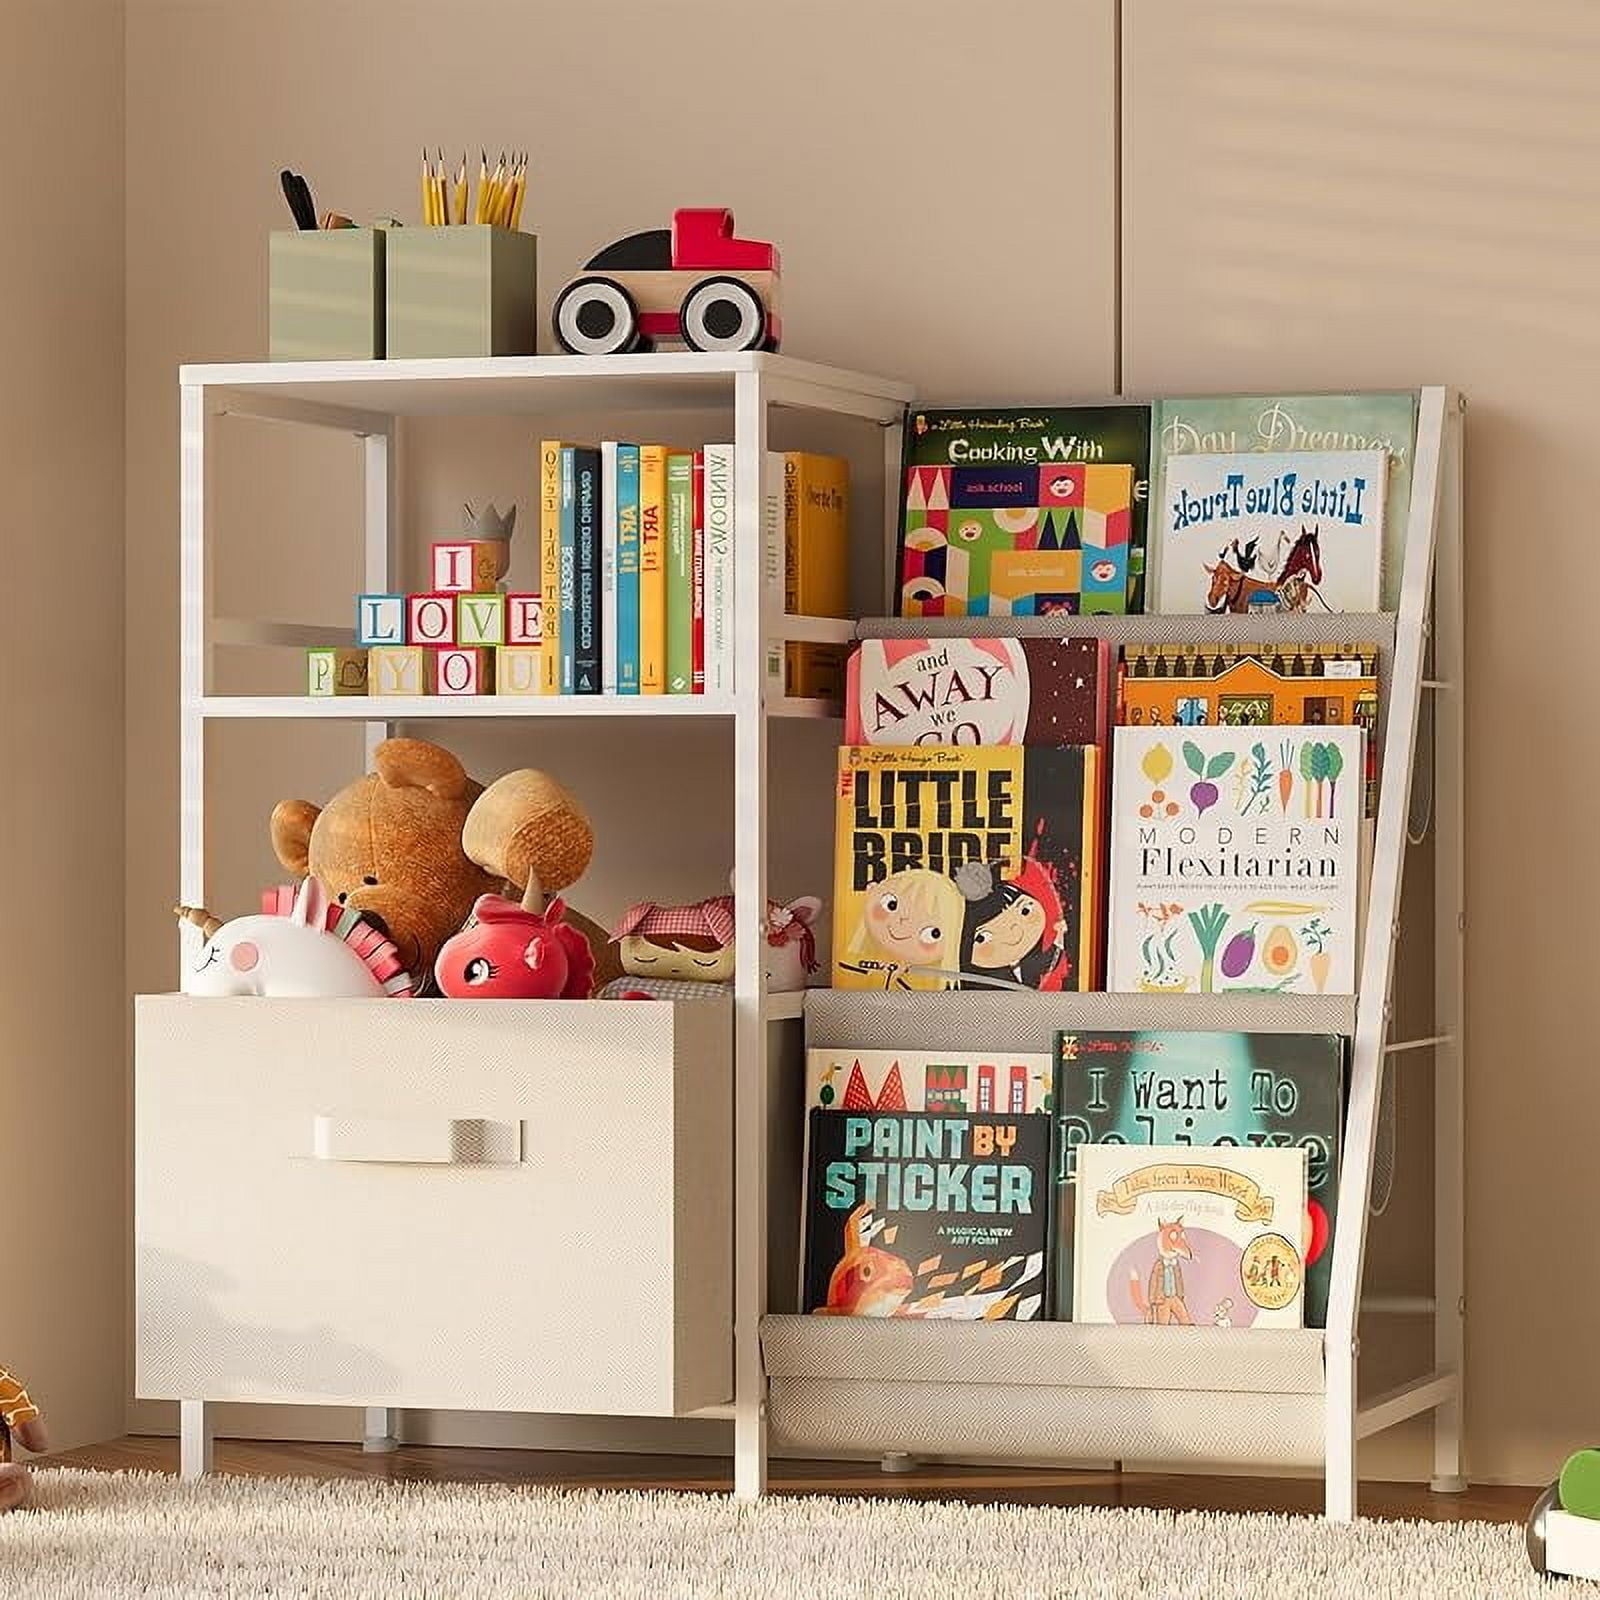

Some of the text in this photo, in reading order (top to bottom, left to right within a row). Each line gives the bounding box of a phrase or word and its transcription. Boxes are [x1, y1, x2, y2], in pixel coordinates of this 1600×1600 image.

[949, 436, 1104, 465] Cooking With
[367, 601, 542, 640] LOVE
[916, 647, 950, 673] and
[872, 665, 1003, 733] AWAY
[930, 708, 957, 728] we
[840, 768, 854, 798] THE
[854, 770, 1013, 829] LITTLE
[1139, 827, 1340, 845] MODERN
[1141, 847, 1337, 878] Flexitarian
[1087, 1067, 1298, 1116] I Want To
[845, 1117, 1017, 1159] PAINT BY
[825, 1161, 1033, 1215] STICKER
